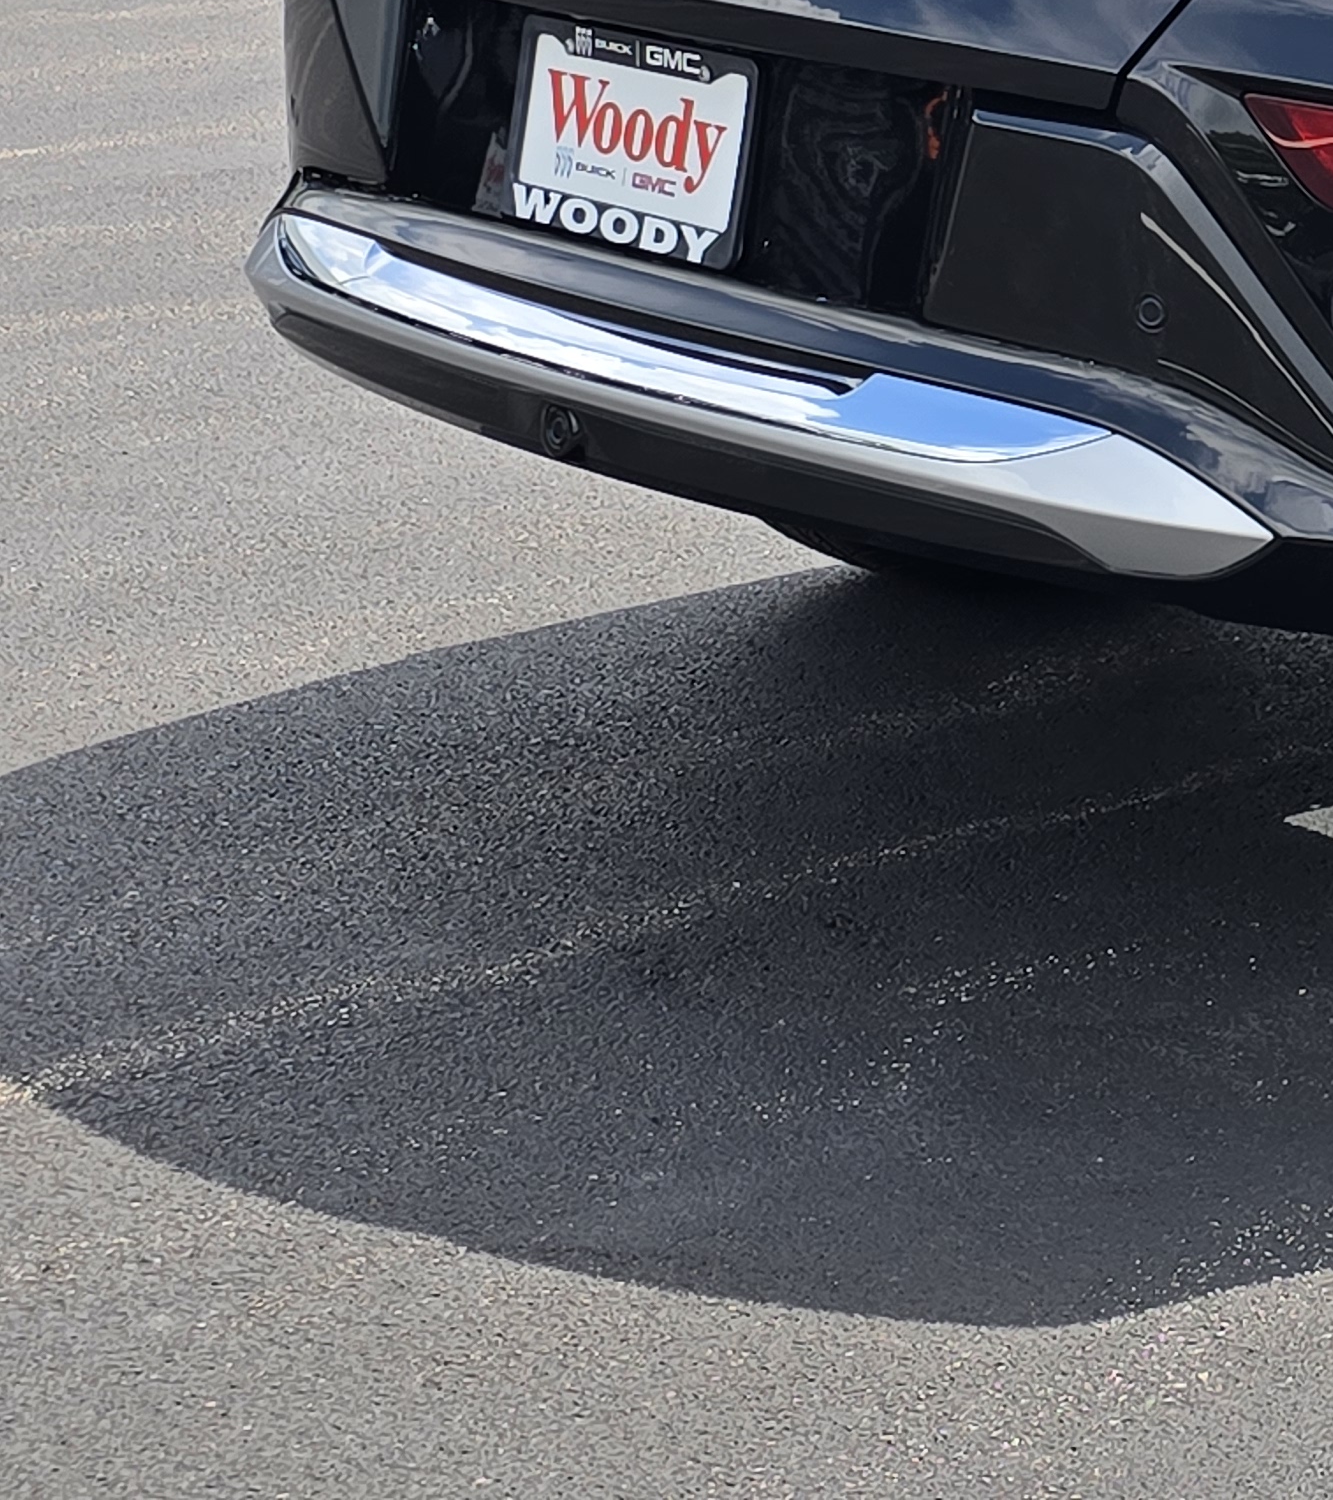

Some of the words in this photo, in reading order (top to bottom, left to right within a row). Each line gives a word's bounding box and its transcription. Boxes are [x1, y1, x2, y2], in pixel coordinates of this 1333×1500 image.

[645, 45, 702, 75] GMC
[548, 68, 728, 194] Woody
[575, 161, 616, 180] BUICK
[632, 172, 677, 198] GMC
[512, 183, 721, 264] WOODY
